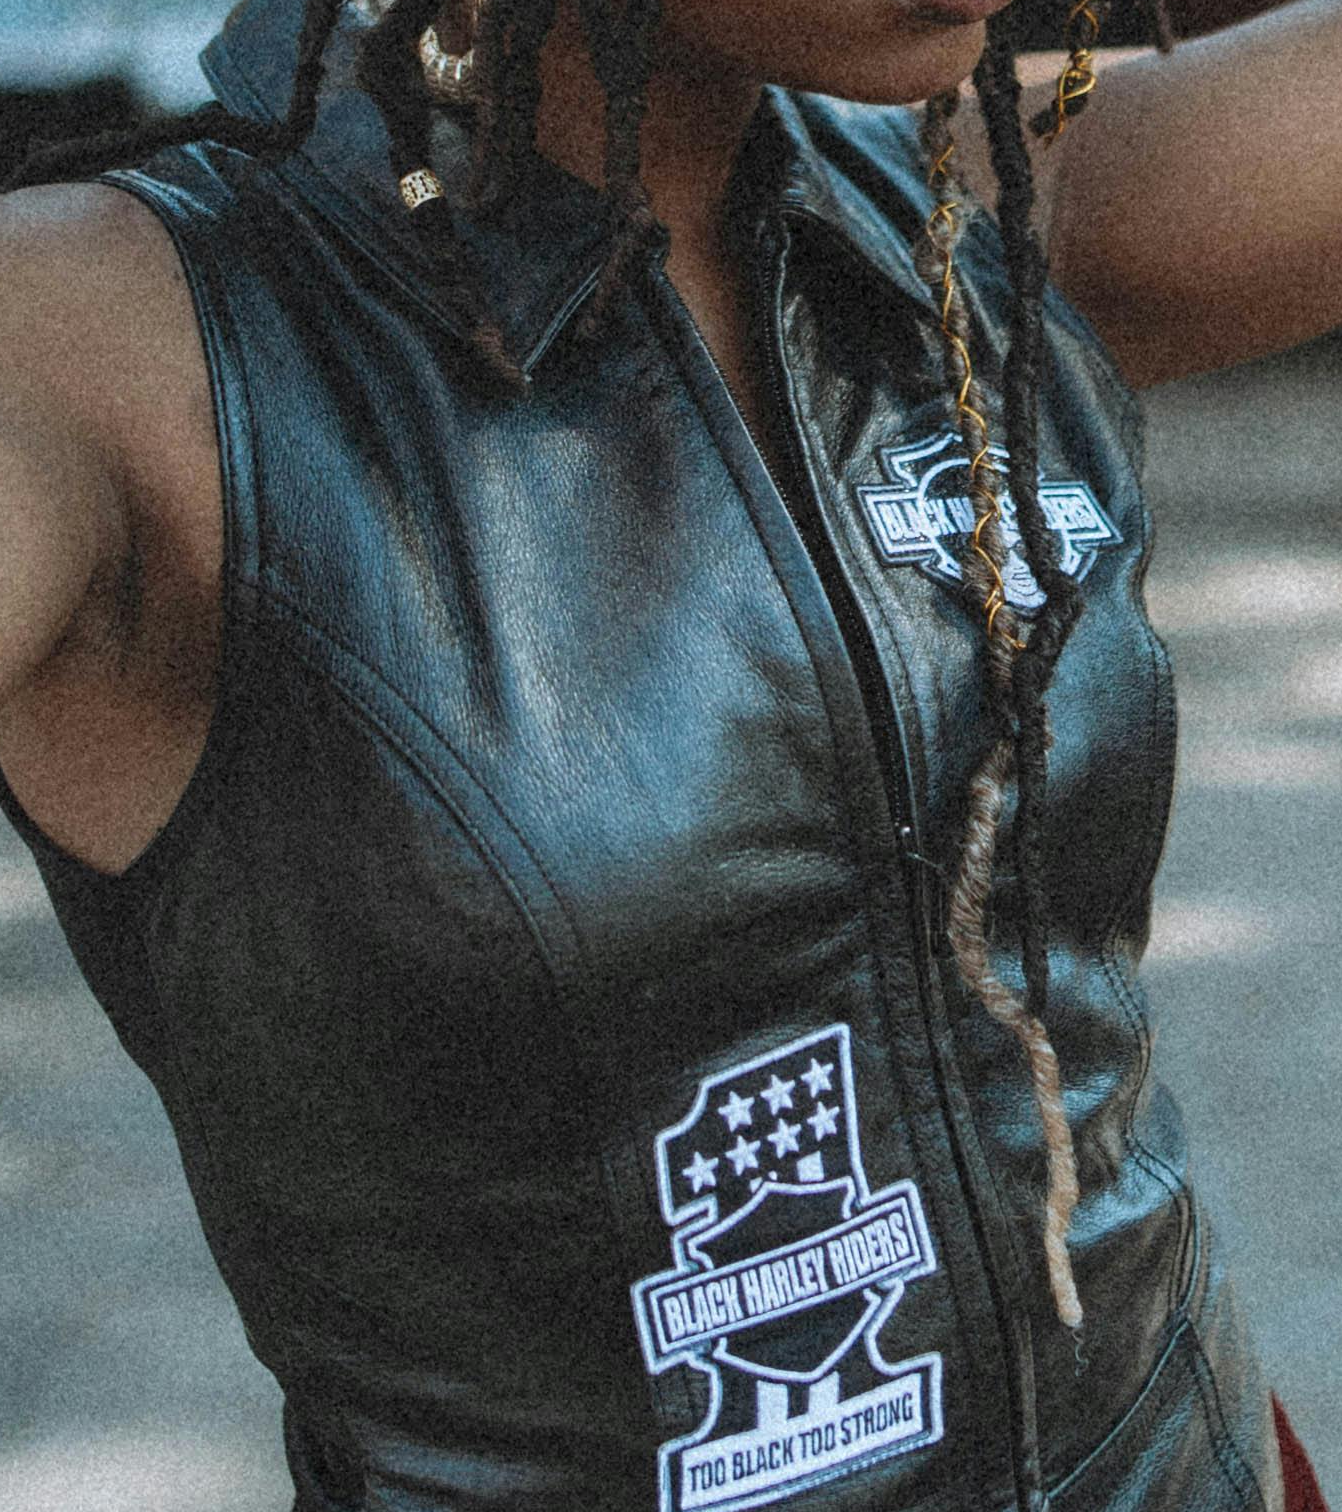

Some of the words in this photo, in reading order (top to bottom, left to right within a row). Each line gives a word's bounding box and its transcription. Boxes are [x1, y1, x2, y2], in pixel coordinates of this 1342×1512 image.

[662, 1275, 744, 1341] BLACK
[741, 1245, 829, 1316] HARLEY
[826, 1211, 910, 1286] RIDERS
[687, 1457, 727, 1492] TOO
[732, 1436, 794, 1481] BLACK
[797, 1423, 837, 1459] TOO
[840, 1391, 914, 1446] STRONG
